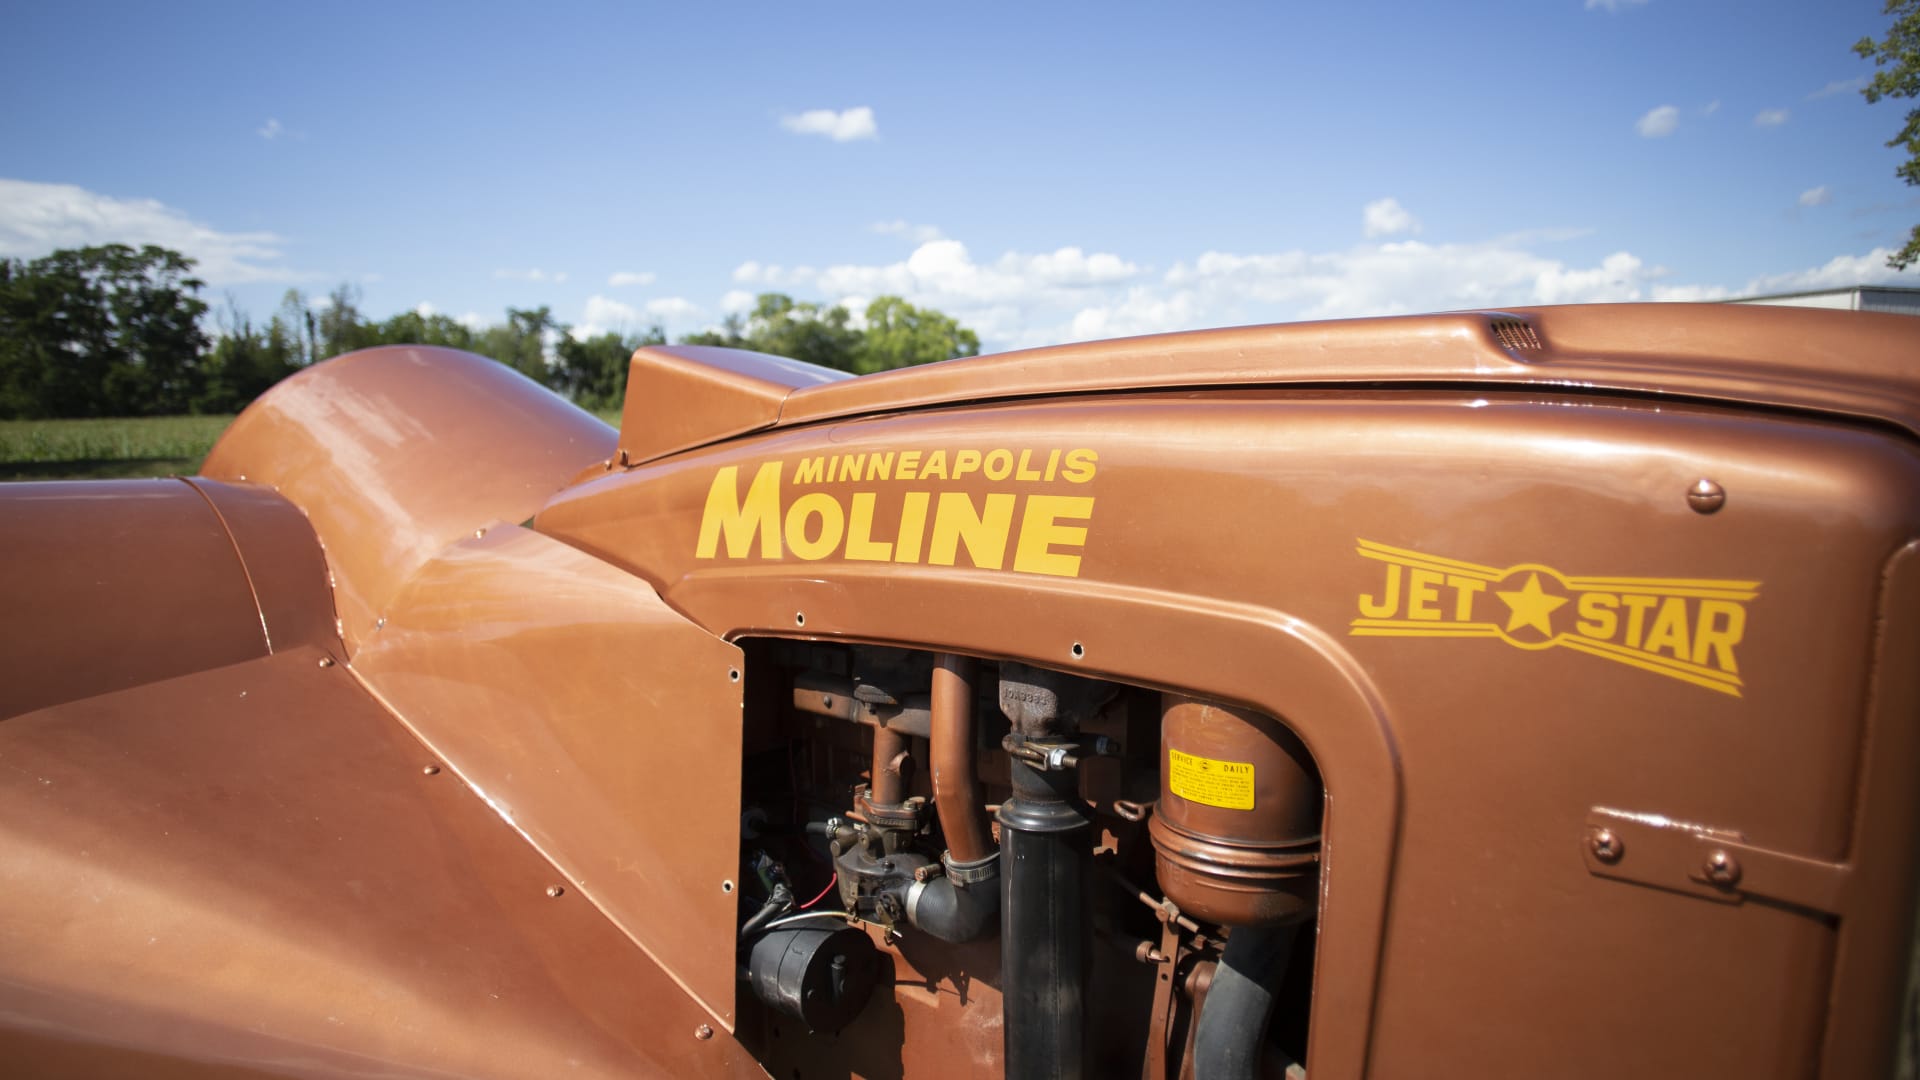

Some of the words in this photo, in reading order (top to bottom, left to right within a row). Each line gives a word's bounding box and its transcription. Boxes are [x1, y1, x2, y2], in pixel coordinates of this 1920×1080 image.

[794, 449, 1098, 483] MINNEAPOLIS
[696, 462, 1094, 577] MOLINE
[1358, 563, 1487, 621] JET
[1576, 592, 1746, 673] STAR
[1223, 764, 1249, 774] DAILY
